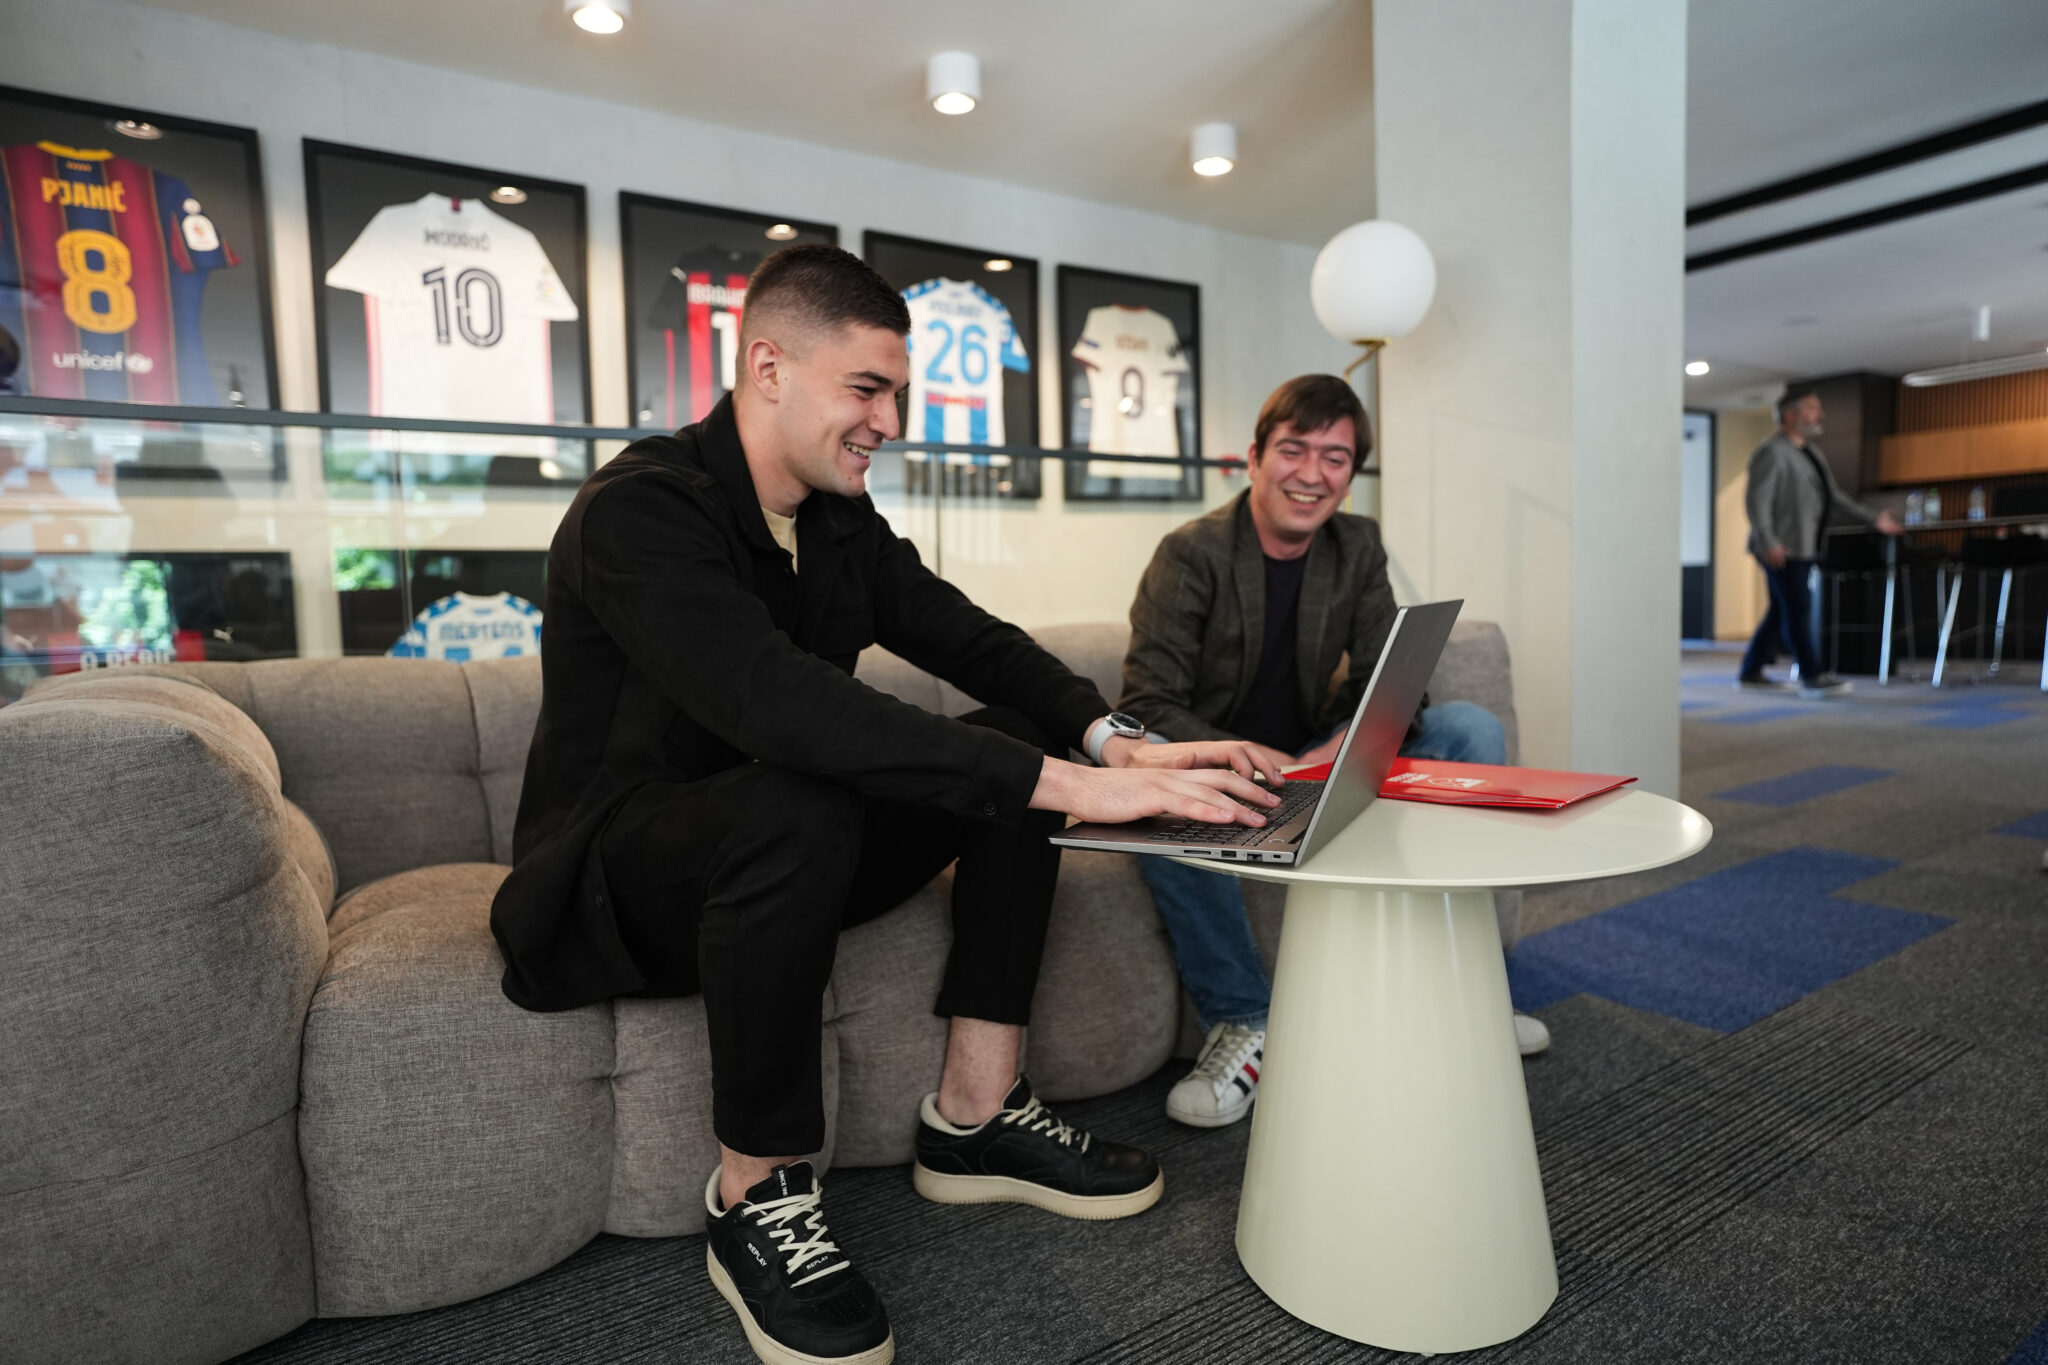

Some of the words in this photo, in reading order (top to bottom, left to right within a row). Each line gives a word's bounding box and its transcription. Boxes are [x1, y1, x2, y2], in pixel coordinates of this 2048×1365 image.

[41, 176, 128, 213] PJANIĆ
[56, 229, 138, 335] 8
[422, 266, 503, 348] 10
[53, 350, 124, 371] unicef
[926, 320, 989, 387] 26
[747, 1242, 768, 1267] REPLAY
[806, 1255, 829, 1270] REPLAY
